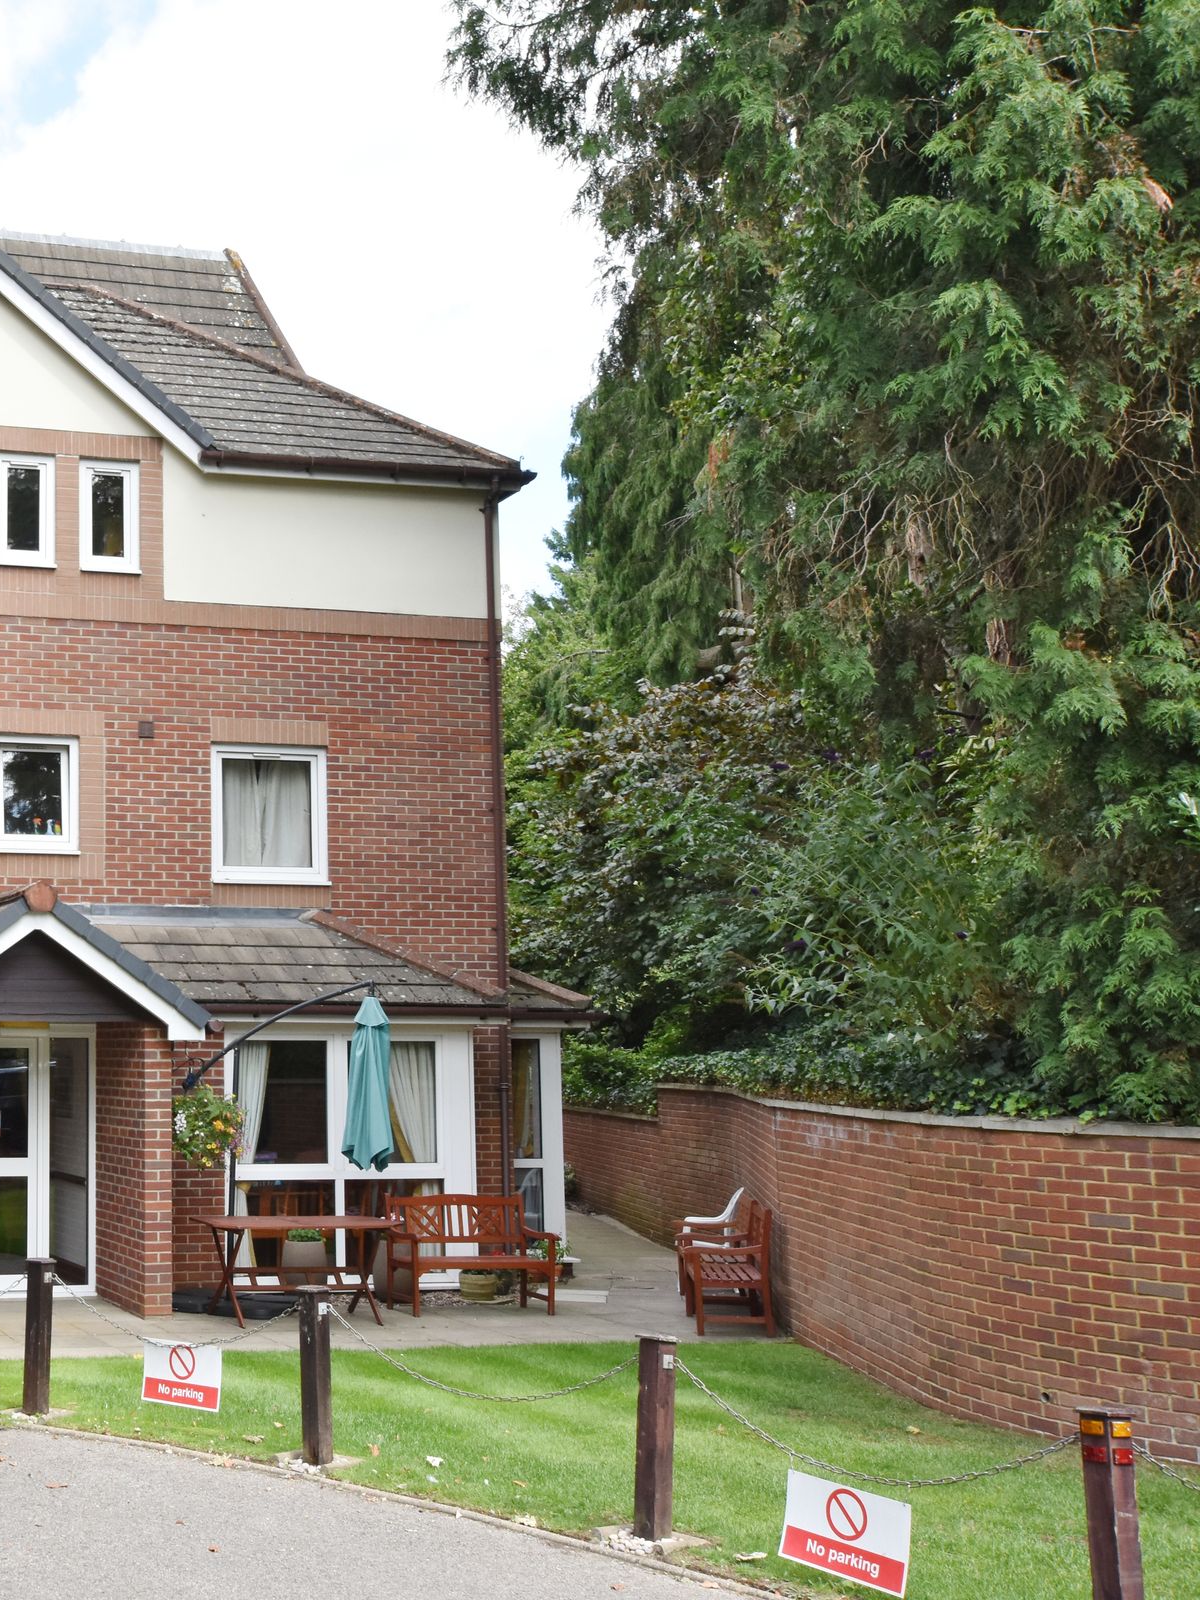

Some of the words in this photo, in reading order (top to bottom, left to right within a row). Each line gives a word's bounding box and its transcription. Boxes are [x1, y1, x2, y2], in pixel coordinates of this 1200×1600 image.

[158, 1383, 170, 1395] No
[171, 1388, 204, 1402] parking
[806, 1538, 825, 1557] No
[828, 1548, 880, 1578] parking
